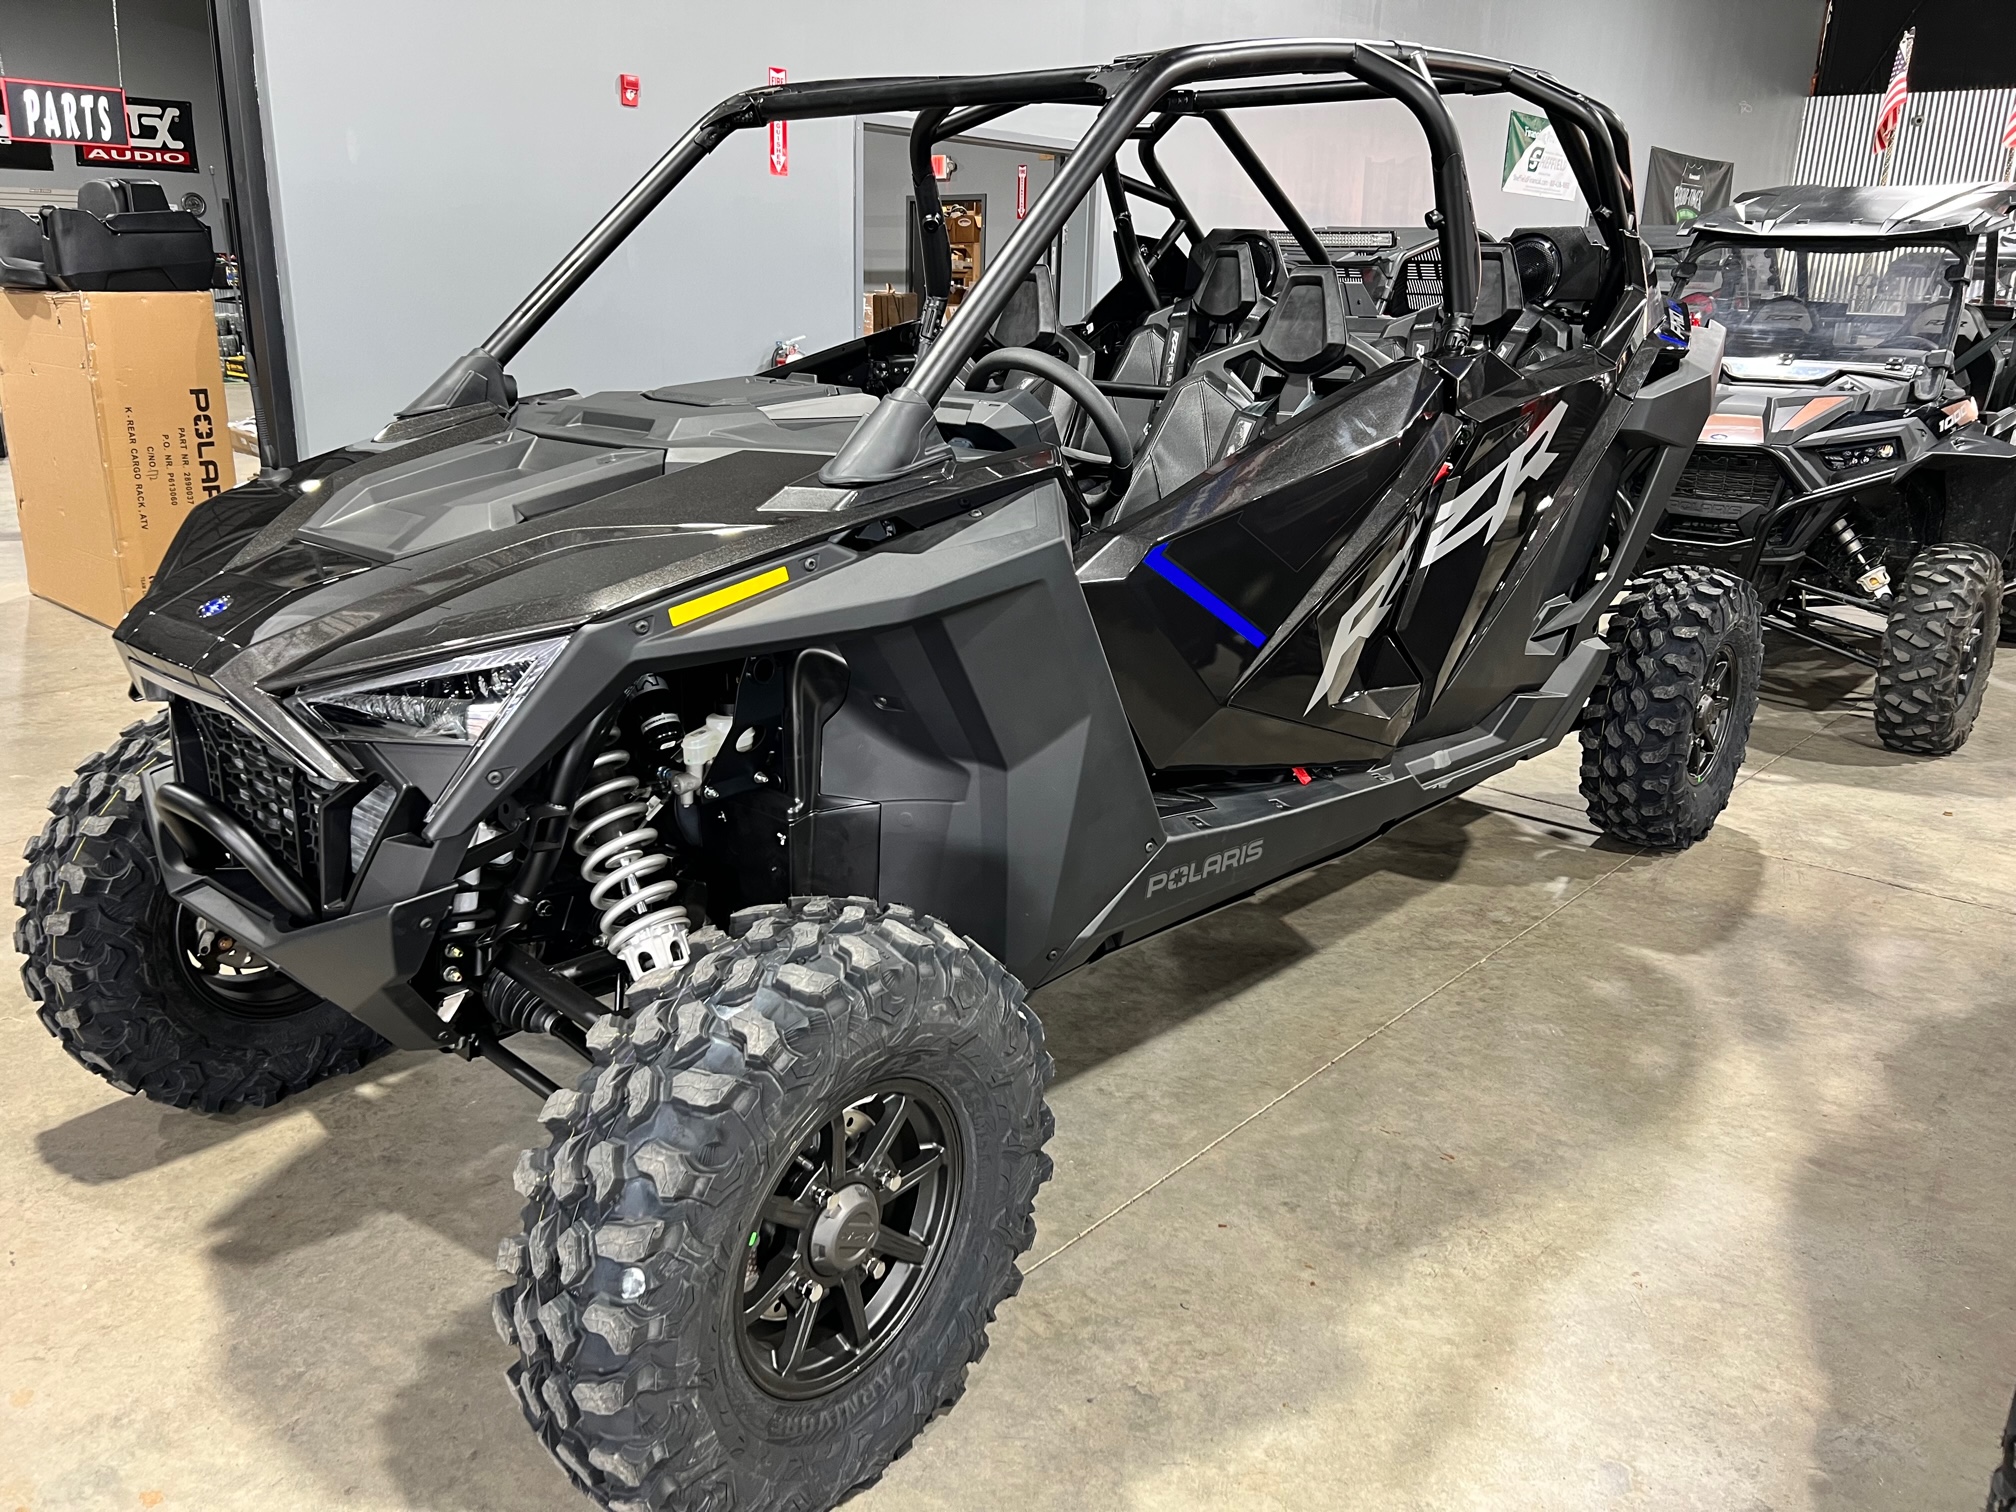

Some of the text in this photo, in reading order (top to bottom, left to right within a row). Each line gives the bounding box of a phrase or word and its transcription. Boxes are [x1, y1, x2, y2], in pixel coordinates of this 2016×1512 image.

[23, 88, 112, 142] PARTS
[126, 104, 184, 149] TX
[88, 148, 185, 164] AUDIO
[130, 448, 142, 480] CARGO
[162, 434, 178, 506] P.O. NR. P613060
[177, 427, 194, 505] PART NR. 2890037
[1146, 838, 1264, 898] POLARIS
